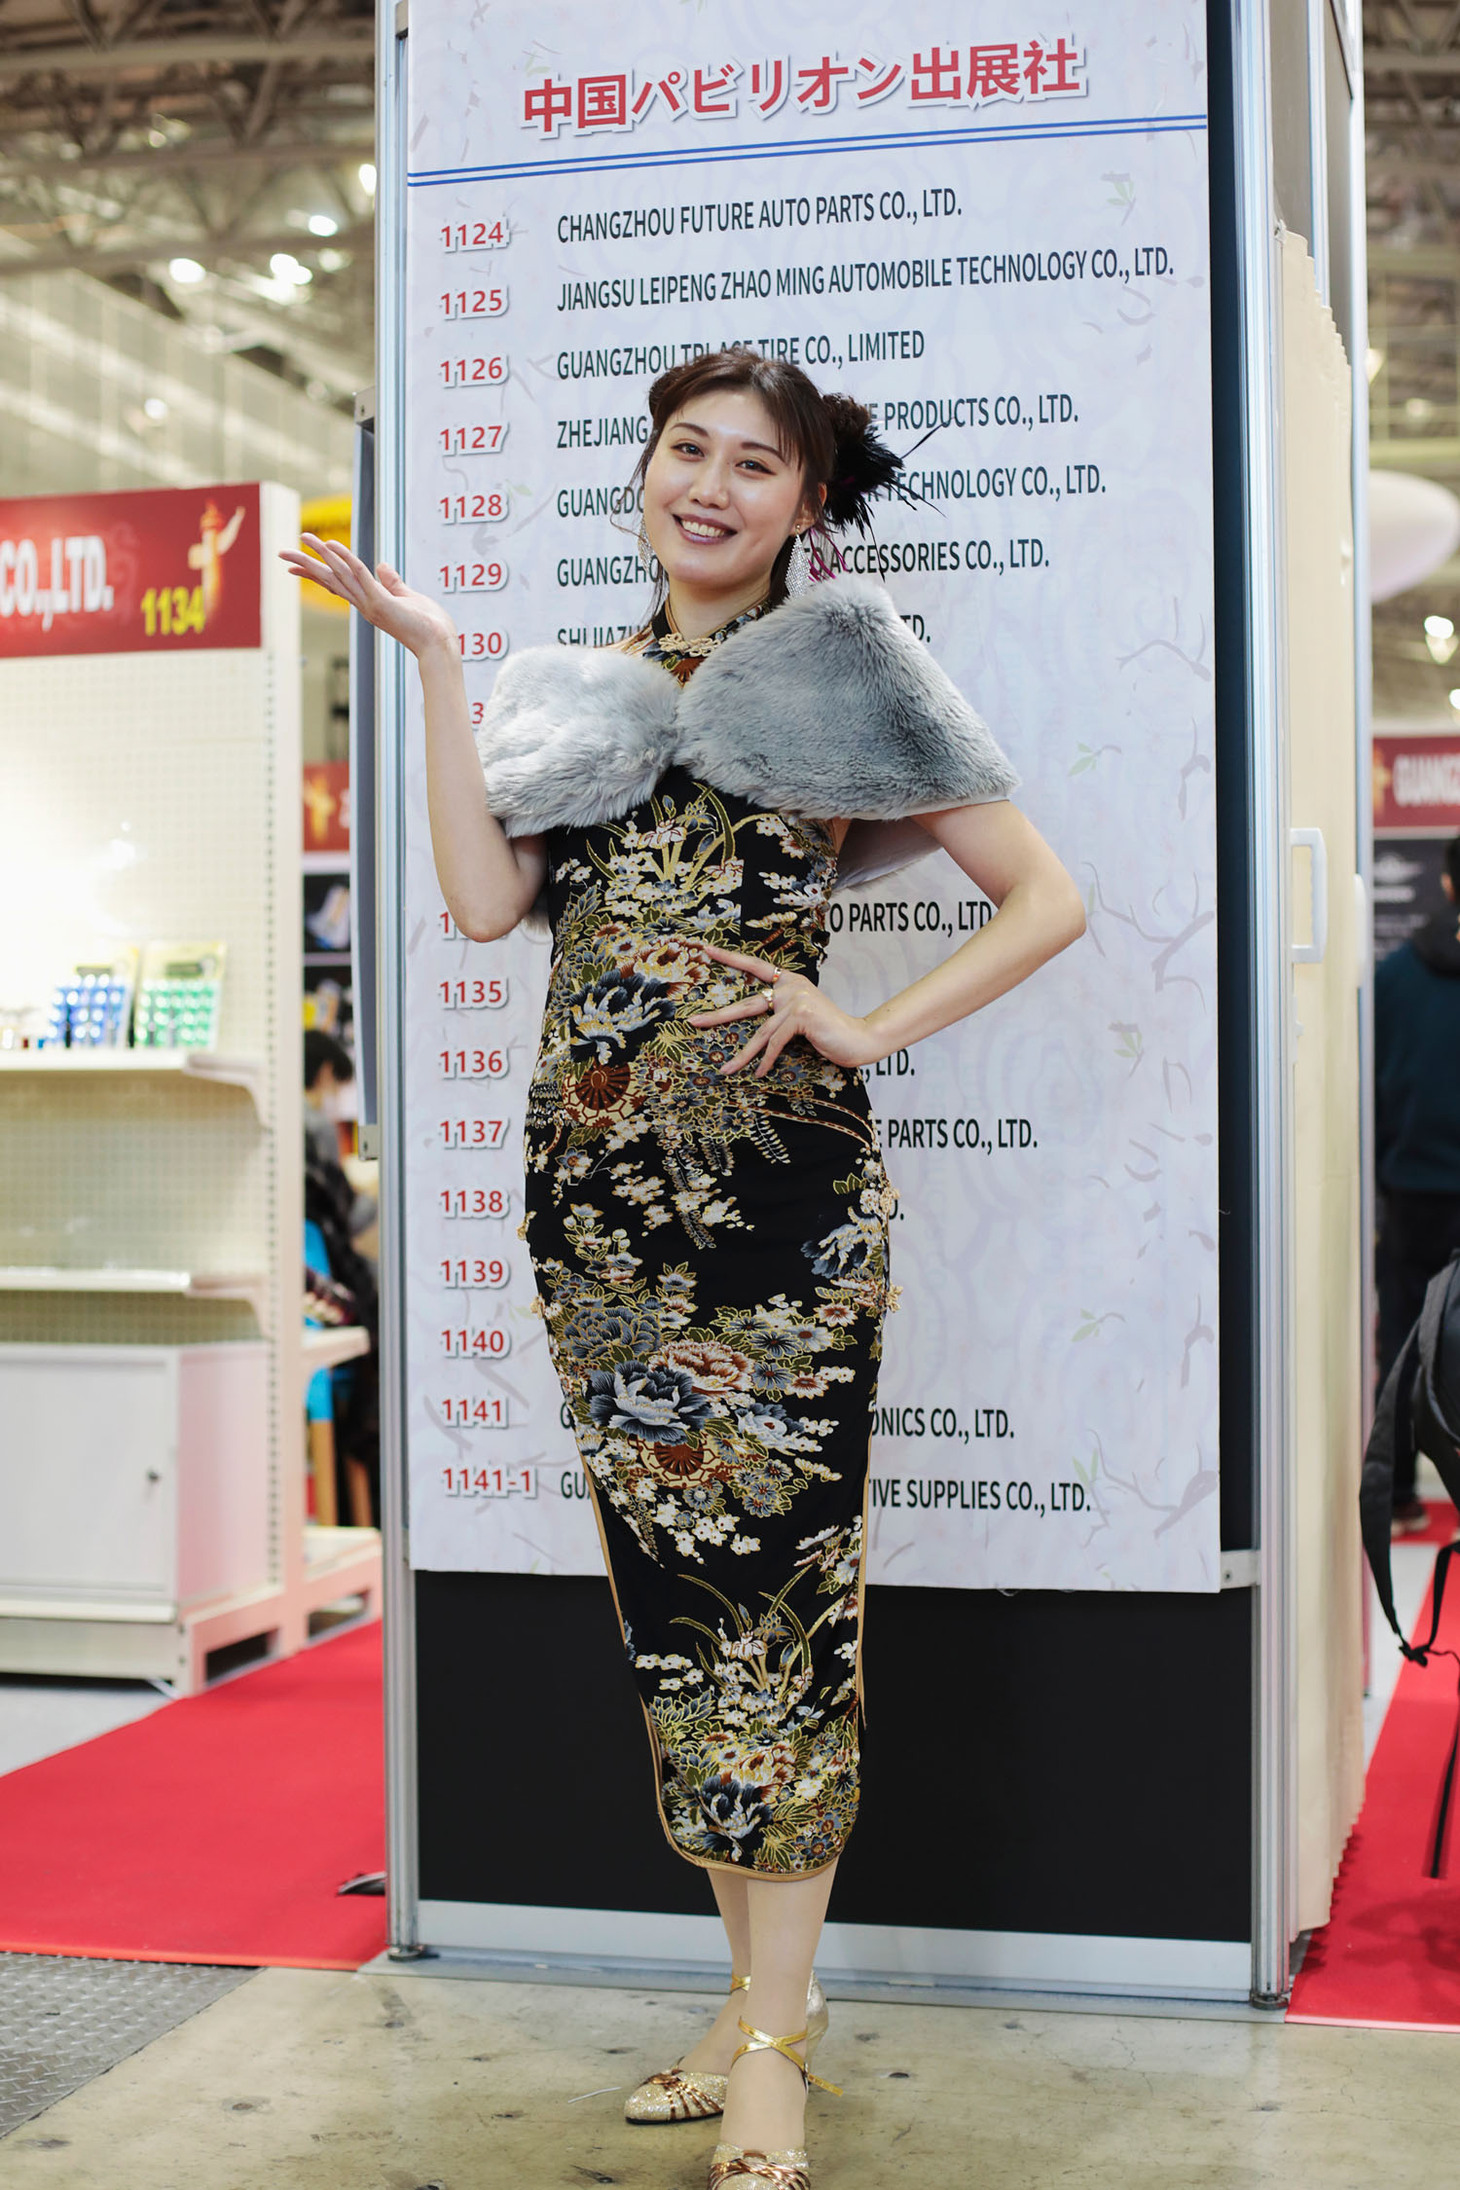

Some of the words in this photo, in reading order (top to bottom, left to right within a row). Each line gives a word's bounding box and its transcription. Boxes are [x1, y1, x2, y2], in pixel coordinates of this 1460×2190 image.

[523, 37, 1081, 133] 中国パビリオン出展社
[558, 208, 674, 243] CHANGZHOU
[681, 202, 753, 233] FUTURE
[759, 198, 810, 228] AUTO
[817, 193, 874, 224] PARTS
[880, 191, 917, 224] CO.,
[924, 189, 961, 217] LTD.
[440, 220, 505, 248] 1124
[557, 279, 634, 311] JIANGSU
[641, 273, 715, 303] LEIPENG
[721, 270, 771, 299] ZHAO
[777, 266, 824, 296] MING
[829, 258, 951, 293] AUTOMOBILE
[957, 251, 1086, 285] TECHNOLOGY
[1092, 249, 1129, 283] CO.,
[1135, 247, 1173, 275] LTD.
[440, 288, 503, 315] 1125
[557, 345, 676, 379] GUANGZHOU
[758, 338, 800, 365] TIRE
[806, 336, 842, 369] CO.,
[849, 331, 924, 361] LIMITED
[440, 356, 504, 383] 1126
[557, 416, 648, 448] ZHEJIANG
[885, 398, 989, 430] PRODUCTS
[995, 396, 1032, 430] CO.,
[1040, 394, 1078, 423] LTD.
[439, 424, 503, 451] 1127
[1022, 466, 1060, 501] CO.,
[1067, 465, 1105, 493] LTD.
[439, 493, 503, 520] 1128
[831, 542, 960, 574] ACCESSORIES
[966, 540, 1003, 575] CO.,
[1010, 539, 1048, 567] LTD.
[439, 562, 503, 588] 1129
[140, 585, 206, 636] 1134
[849, 902, 909, 932] PARTS
[914, 901, 953, 937] CO.,
[440, 979, 503, 1004] 1135
[440, 1049, 504, 1074] 1136
[439, 1119, 503, 1144] 1137
[888, 1119, 948, 1148] PARTS
[953, 1119, 992, 1155] CO.,
[998, 1119, 1037, 1148] LTD.
[440, 1189, 504, 1214] 1138
[441, 1259, 504, 1283] 1139
[442, 1329, 505, 1354] 1140
[442, 1398, 502, 1422] 1141
[931, 1408, 969, 1444] CO.,
[975, 1409, 1014, 1438] LTD.
[443, 1467, 531, 1493] 1141-1
[907, 1479, 1001, 1510] SUPPLIES
[1006, 1481, 1045, 1518] CO.,
[1051, 1483, 1090, 1511] LTD.
